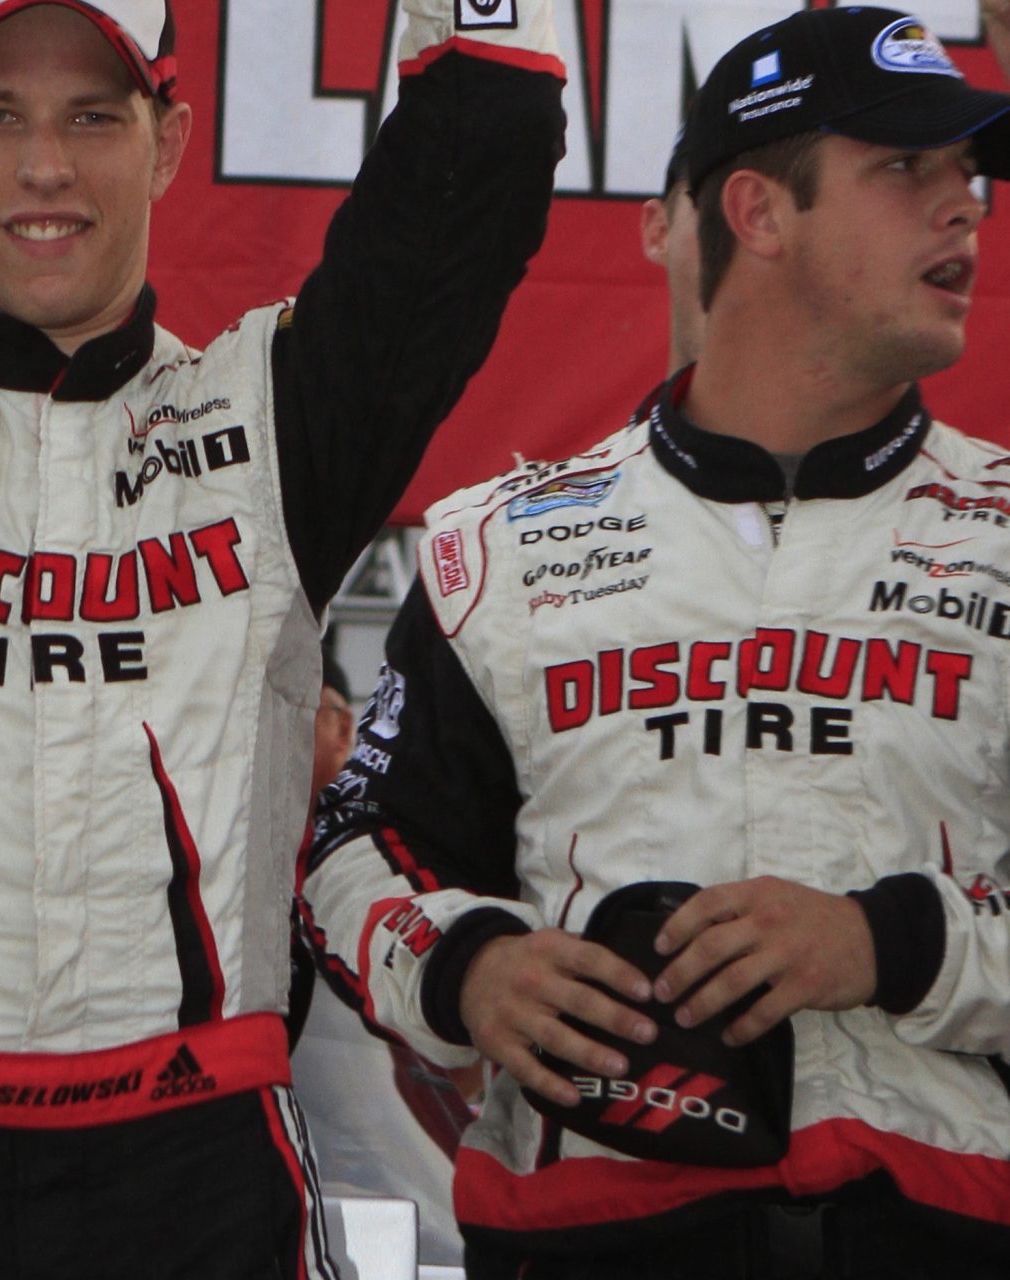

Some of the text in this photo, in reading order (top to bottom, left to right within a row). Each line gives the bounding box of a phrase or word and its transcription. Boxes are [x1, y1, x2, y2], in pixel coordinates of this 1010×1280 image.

[176, 397, 231, 424] wireless
[115, 438, 203, 509] Mobil
[520, 513, 648, 546] DODGE
[439, 533, 464, 592] SIMPSON
[869, 580, 988, 631] Mobil
[544, 625, 973, 734] DISCOUNT
[645, 700, 854, 761] TIRE
[149, 1074, 218, 1102] adidas
[572, 1075, 747, 1134] DODGE
